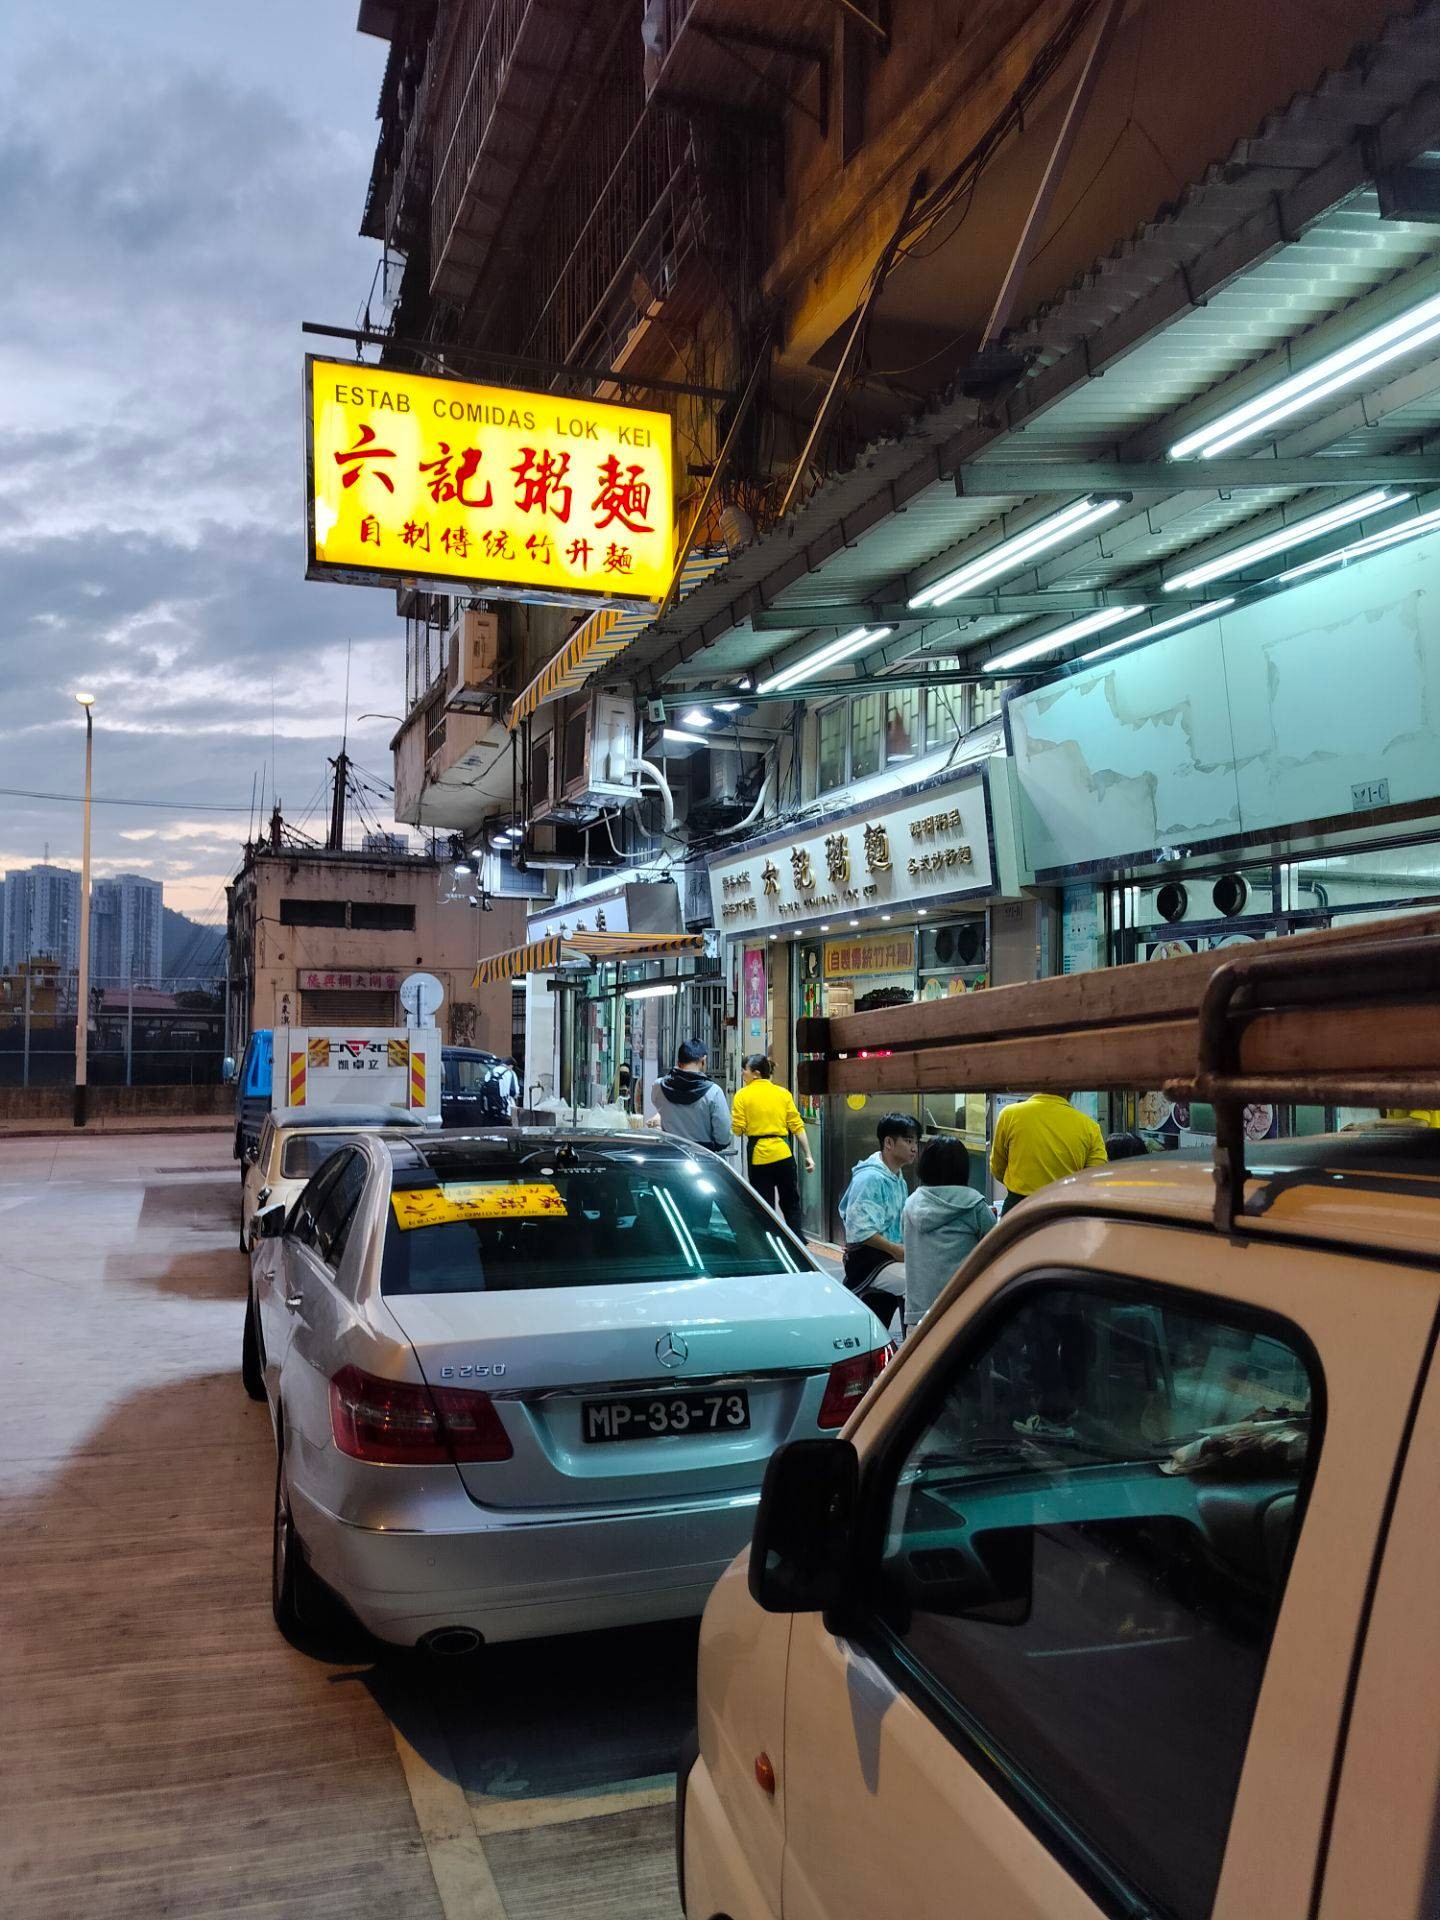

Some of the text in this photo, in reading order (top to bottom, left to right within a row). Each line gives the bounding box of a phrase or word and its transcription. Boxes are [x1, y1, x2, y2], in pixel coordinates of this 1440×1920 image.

[335, 384, 652, 447] ESTAB COMIDAS LOK KEI
[334, 423, 656, 533] 六記粥麵
[588, 1395, 745, 1438] MP-33-73
